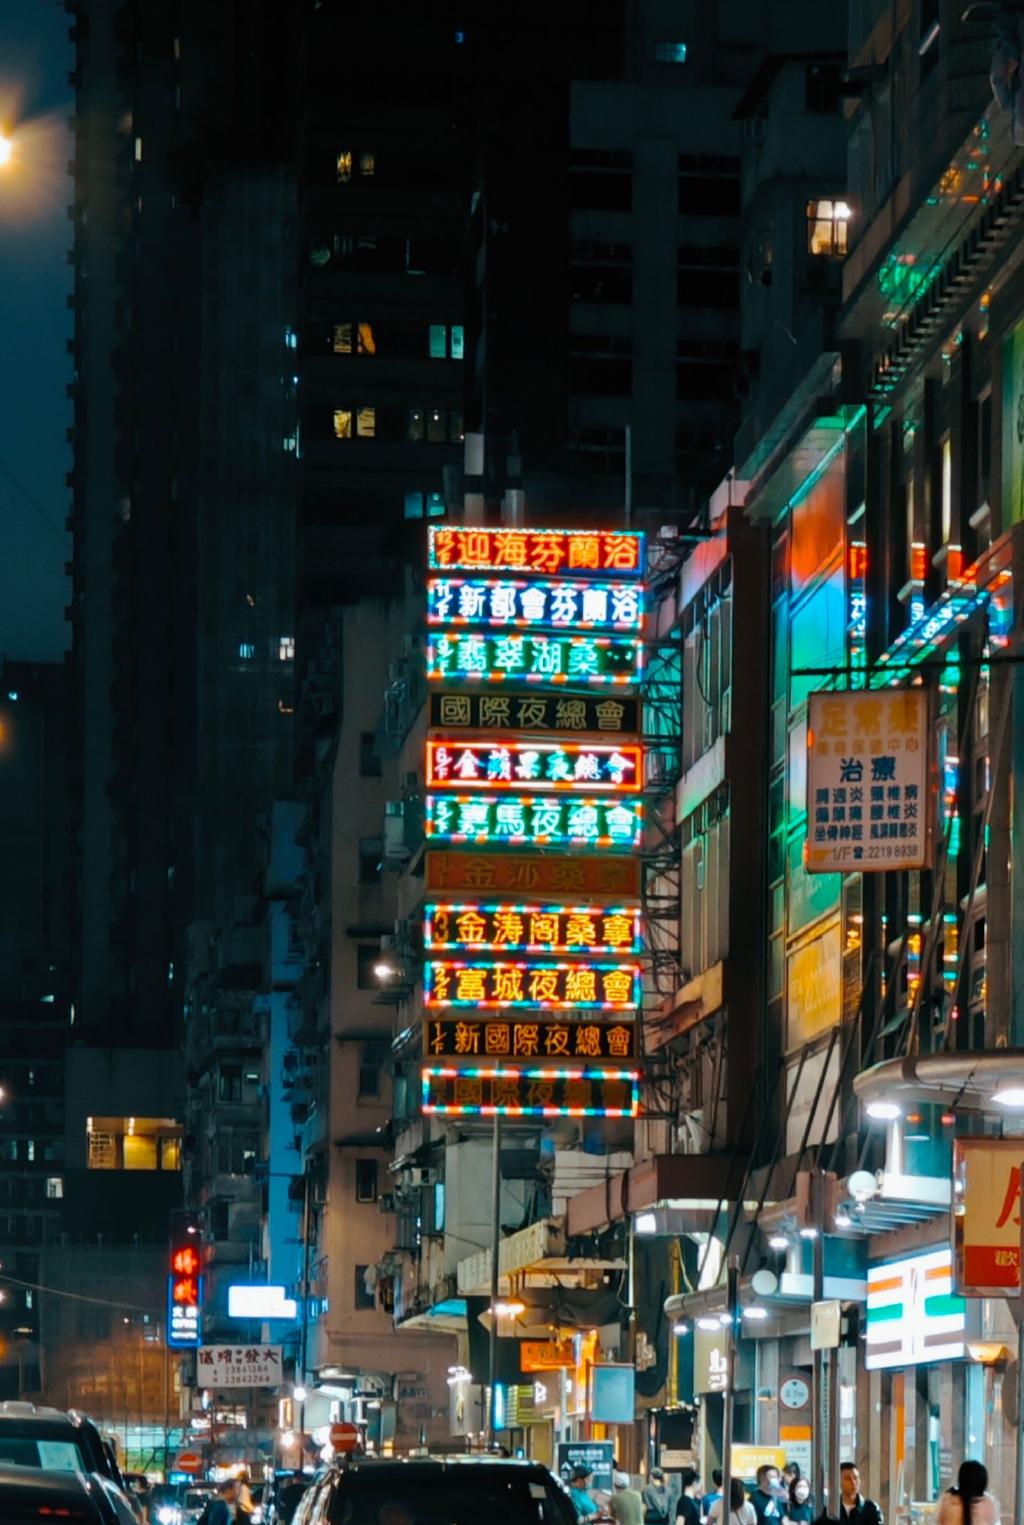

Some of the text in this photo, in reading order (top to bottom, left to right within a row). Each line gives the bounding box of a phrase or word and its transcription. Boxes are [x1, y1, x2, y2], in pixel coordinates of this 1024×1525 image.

[457, 533, 638, 569] 迎海芬蘭浴
[458, 585, 638, 623] 新都會芬蘭浴
[458, 640, 634, 675] 翡翠湖桑
[440, 695, 625, 730] 國際夜總會
[840, 756, 896, 783] 治療
[456, 967, 632, 1002] 富城夜總會
[455, 1021, 630, 1056] 新國際夜總會
